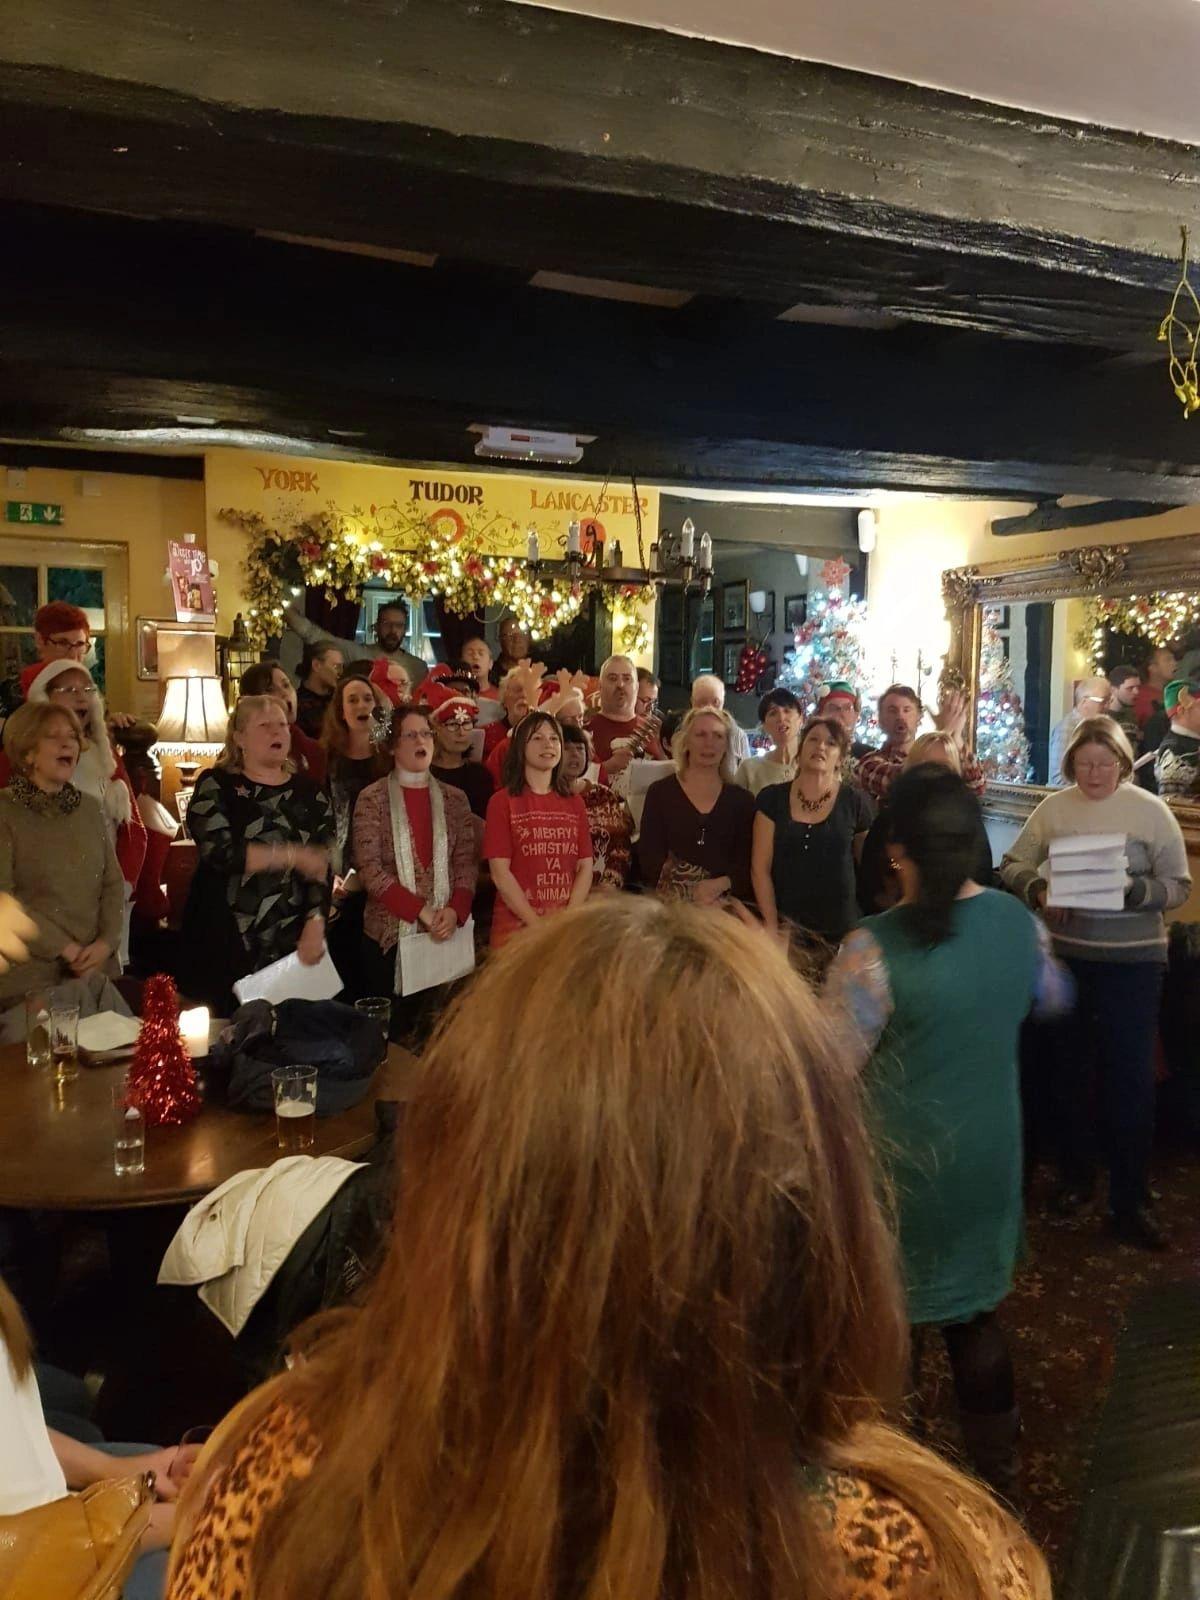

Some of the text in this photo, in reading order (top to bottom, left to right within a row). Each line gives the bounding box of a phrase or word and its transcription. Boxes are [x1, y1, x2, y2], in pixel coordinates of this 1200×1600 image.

[255, 466, 320, 494] YORK
[409, 479, 484, 505] TUDOR
[530, 488, 649, 516] LANCASTER
[533, 827, 571, 839] MERRY
[546, 858, 561, 870] YA
